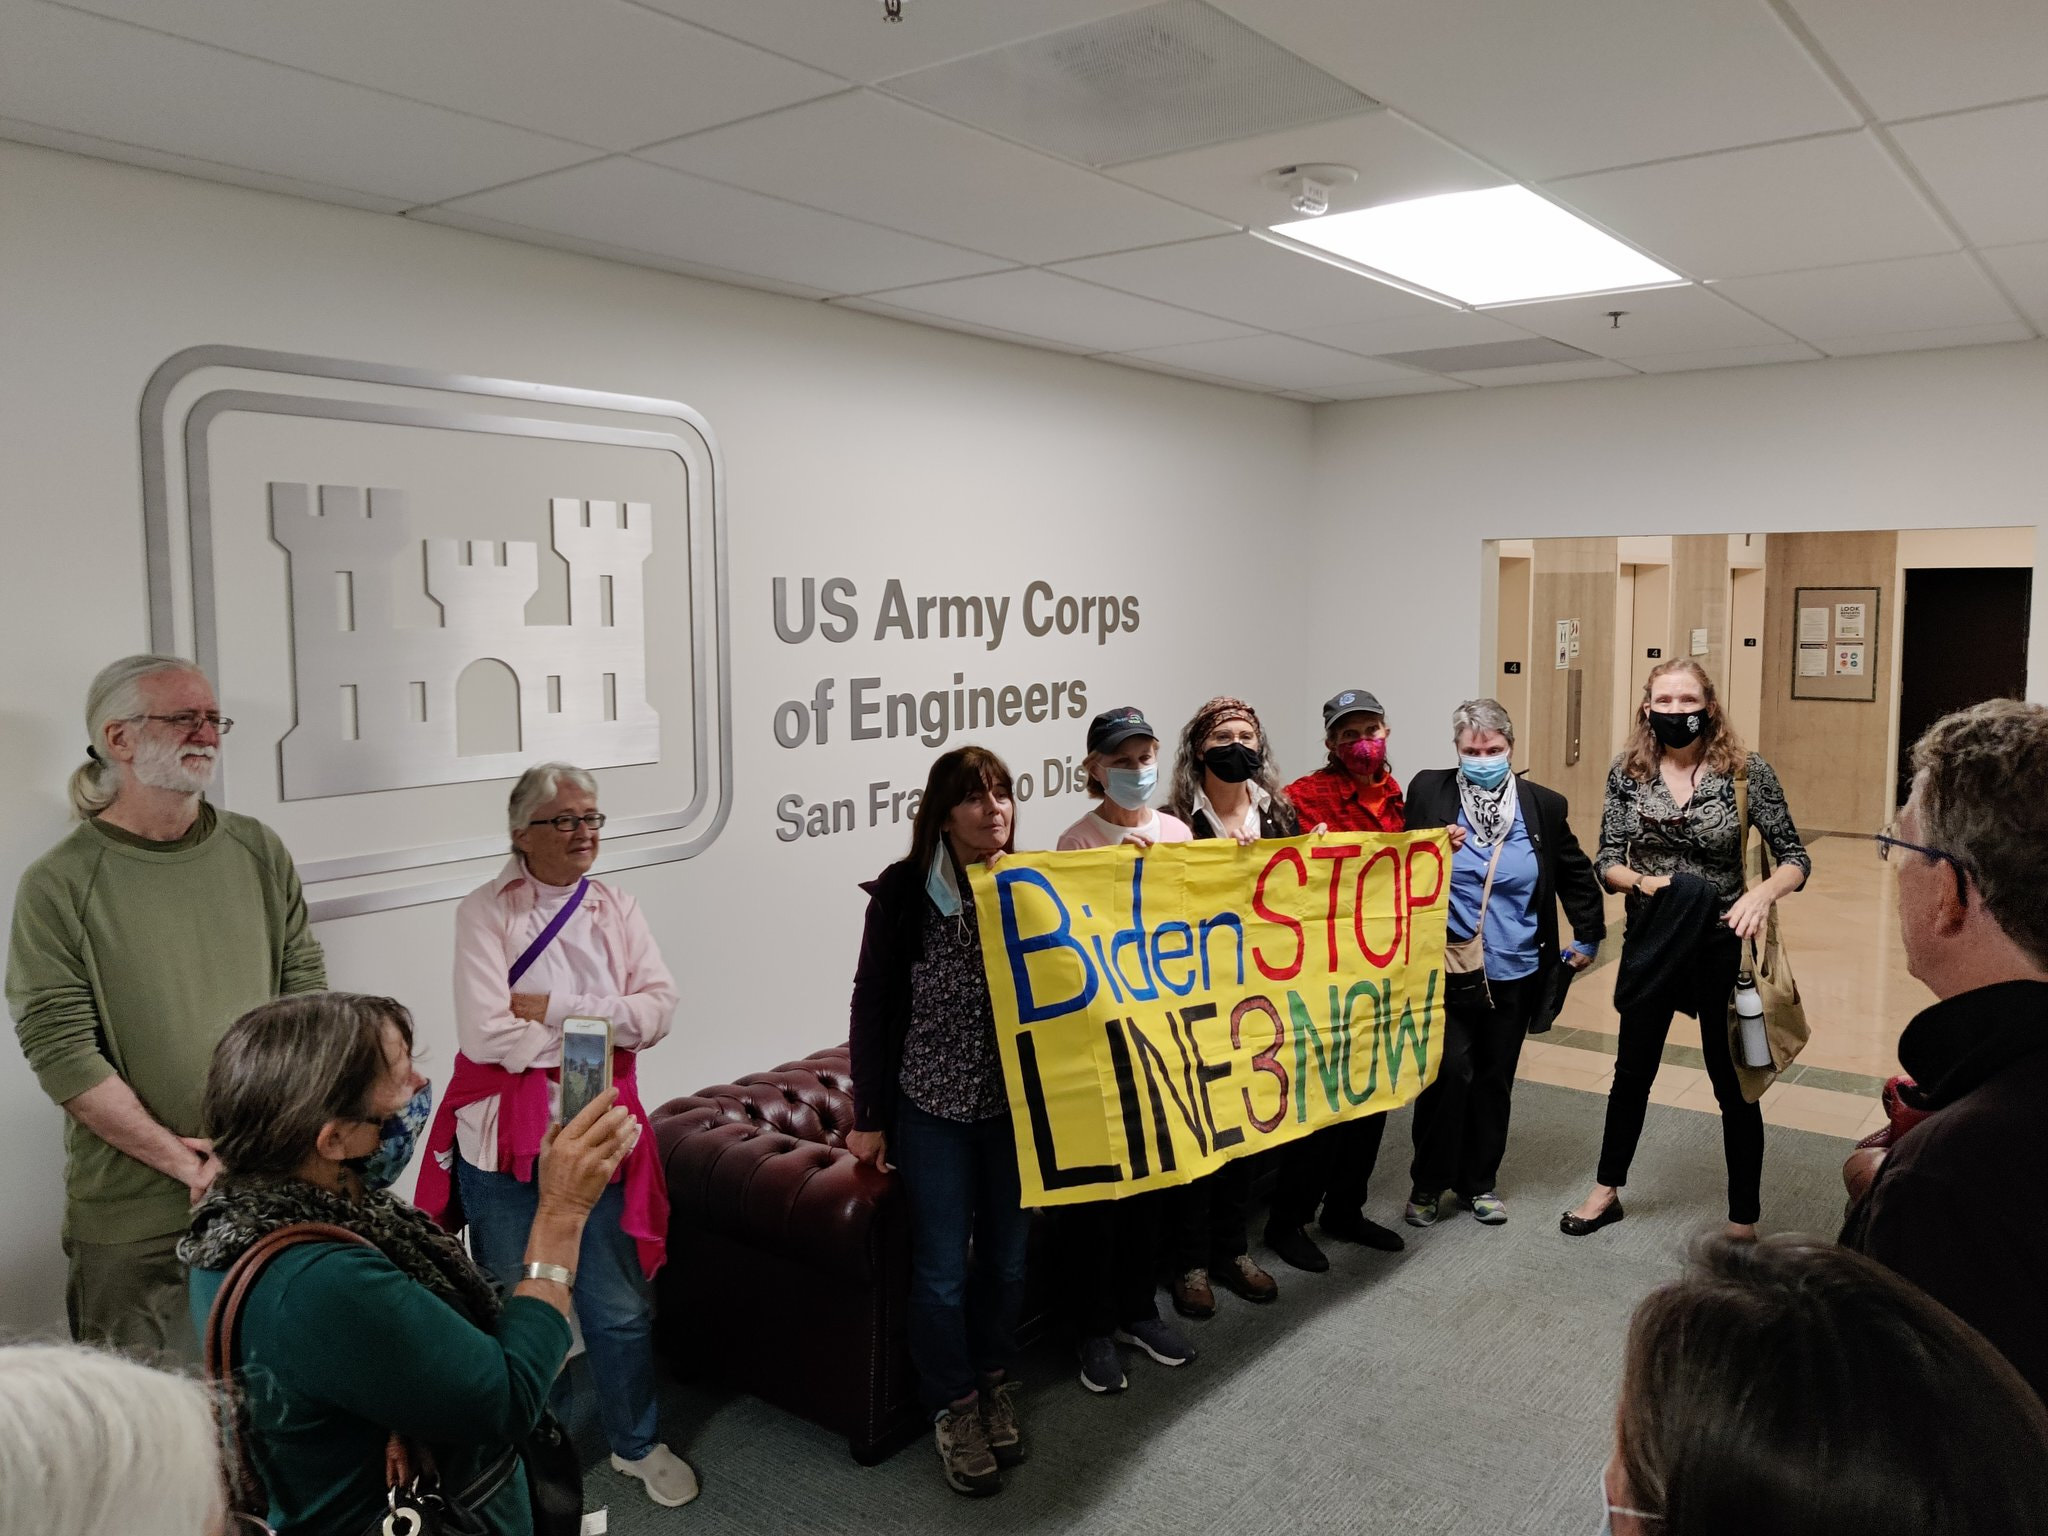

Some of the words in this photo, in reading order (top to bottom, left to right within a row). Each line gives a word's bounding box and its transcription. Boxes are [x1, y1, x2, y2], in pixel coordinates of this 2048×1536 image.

[773, 577, 859, 643] US
[874, 579, 1010, 650] Army
[1022, 581, 1140, 645] Corps
[773, 677, 834, 748] of
[850, 672, 1088, 747] Engineers
[776, 793, 855, 842] San
[995, 857, 1244, 1024] Biden
[1252, 842, 1443, 980] STOP
[1016, 1003, 1245, 1191] LINE
[1230, 996, 1289, 1134] 3
[1288, 970, 1438, 1124] NOW
